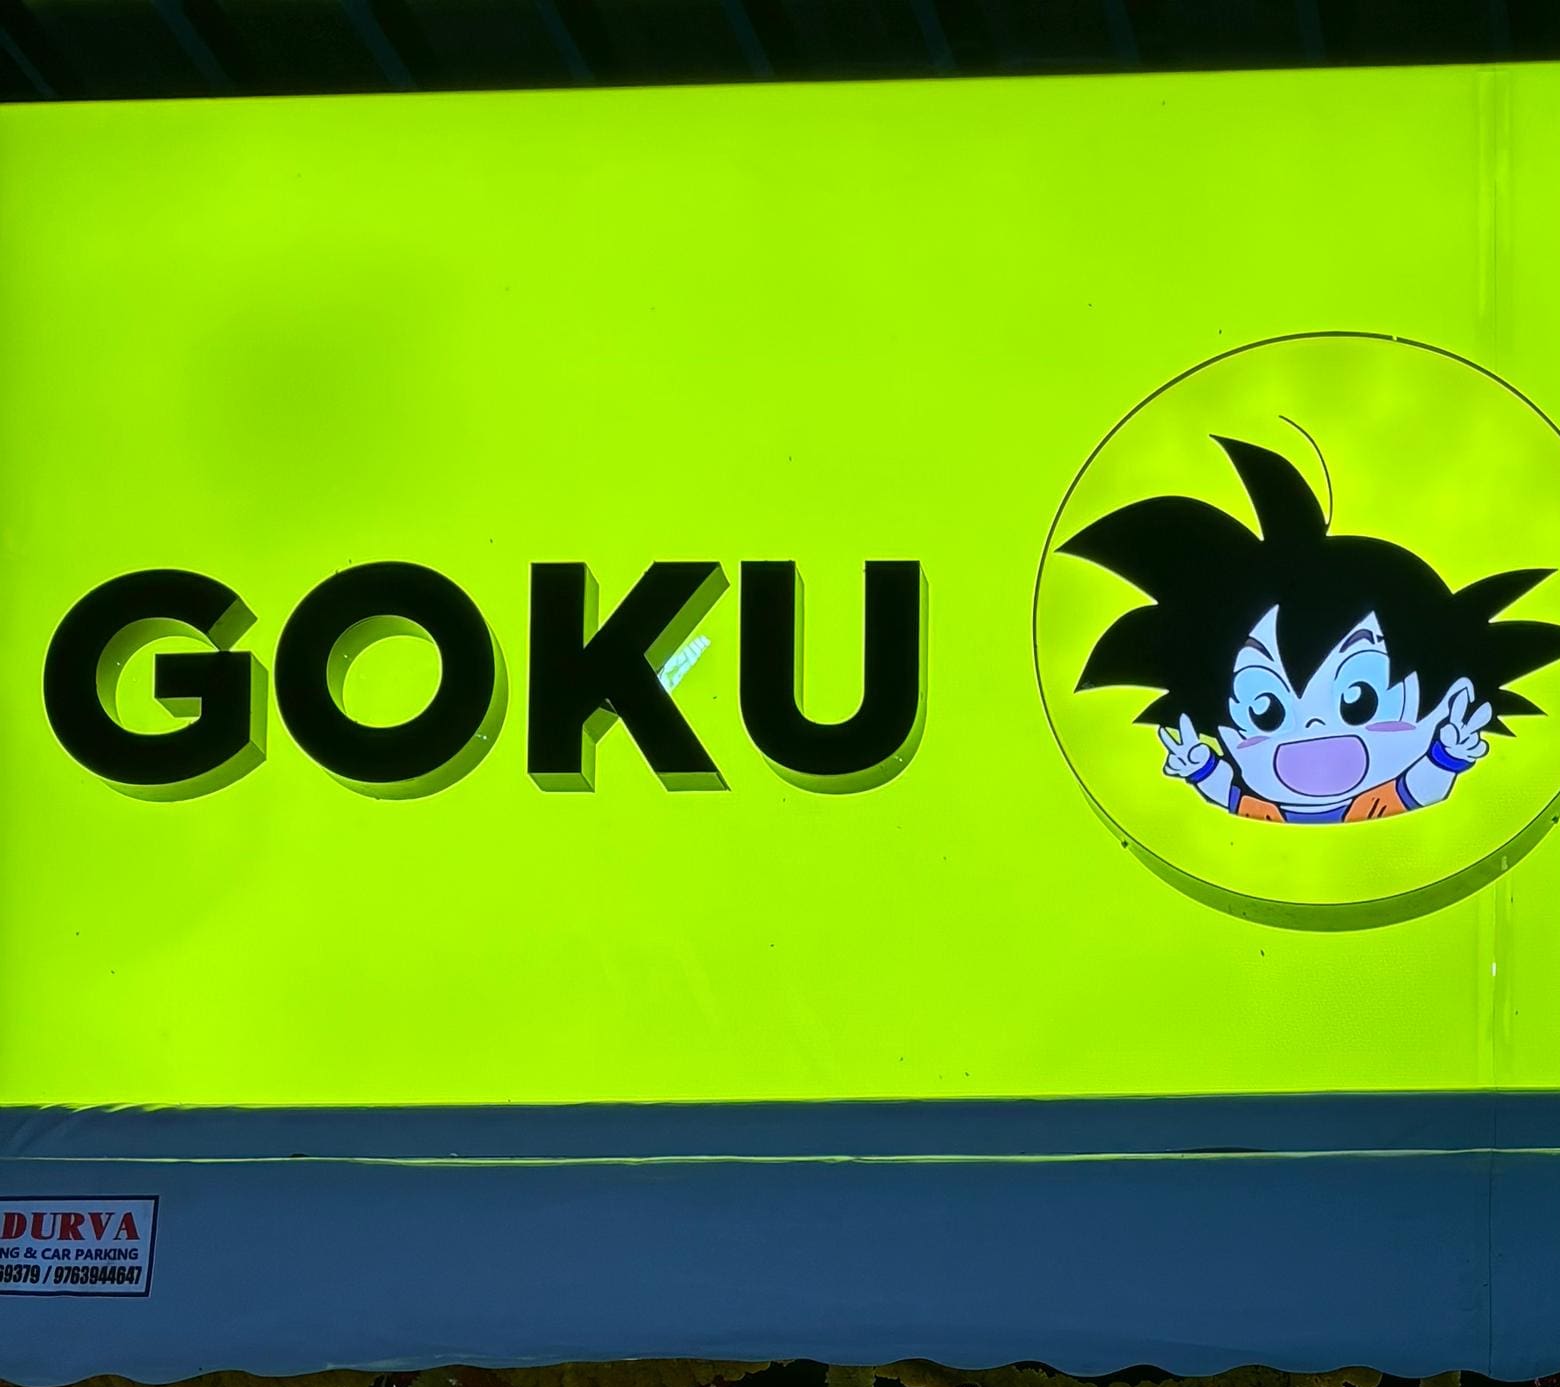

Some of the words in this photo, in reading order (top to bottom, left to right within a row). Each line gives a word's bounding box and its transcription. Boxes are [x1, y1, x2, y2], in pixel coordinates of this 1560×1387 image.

[44, 560, 926, 797] GOKU
[0, 1211, 140, 1241] DURVA
[24, 1246, 37, 1260] &
[41, 1247, 71, 1261] CAR
[75, 1247, 139, 1261] PARKING
[53, 1265, 142, 1285] 9763944647
